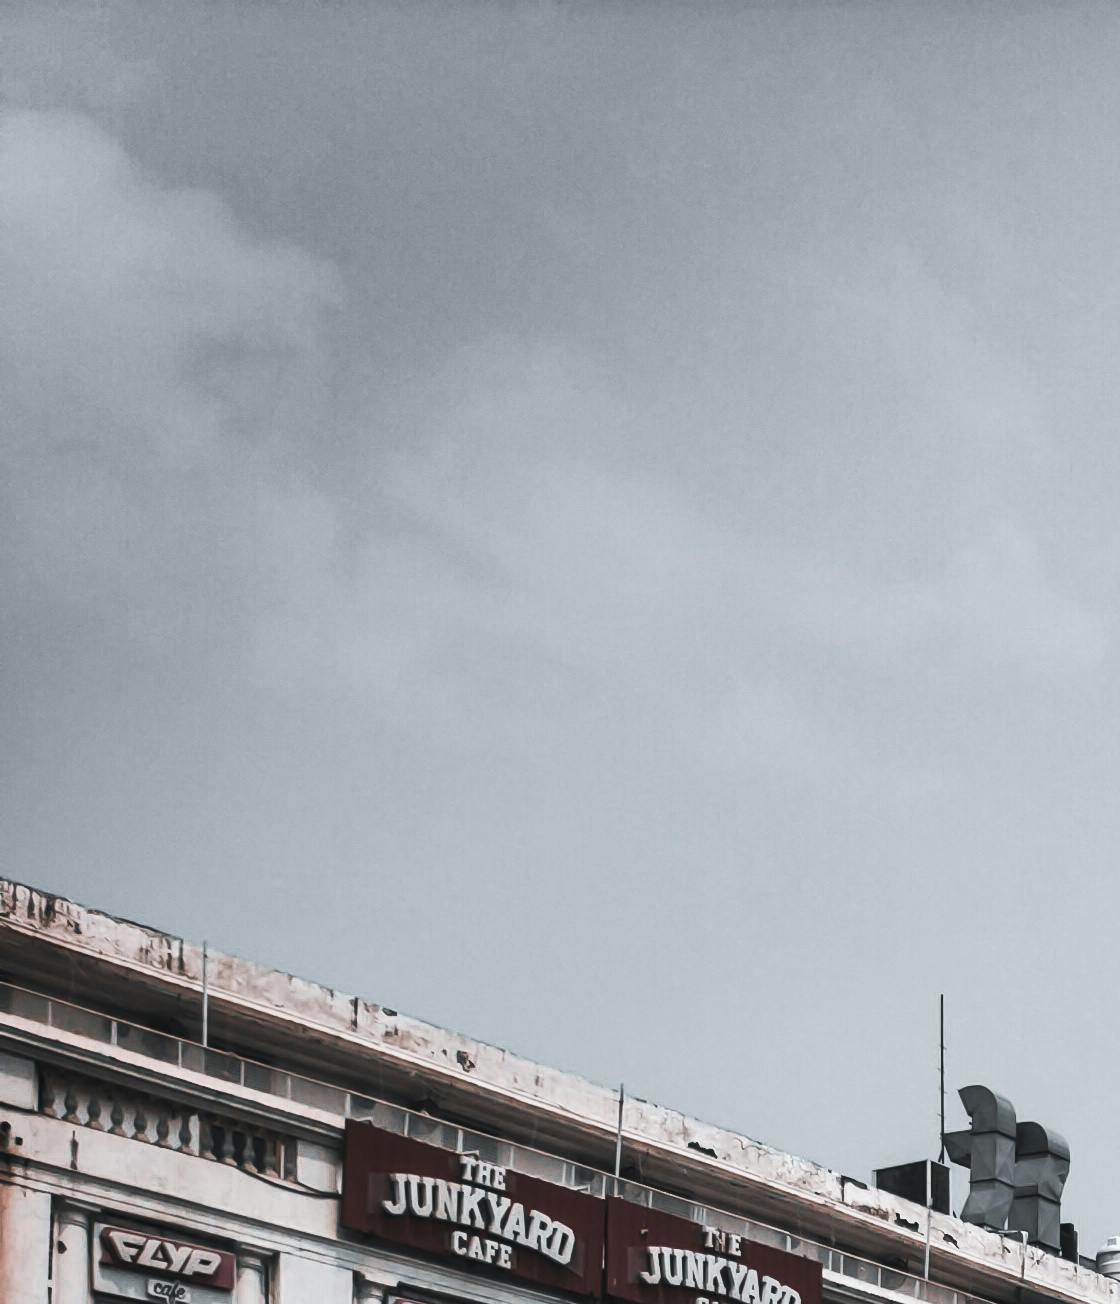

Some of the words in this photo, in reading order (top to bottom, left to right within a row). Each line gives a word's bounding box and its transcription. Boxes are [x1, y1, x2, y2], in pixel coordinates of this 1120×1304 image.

[460, 1156, 506, 1190] THE
[381, 1173, 576, 1265] JUNKYARD
[109, 1231, 221, 1275] FLYP
[452, 1231, 512, 1269] CAFE
[154, 1281, 185, 1304] cafe
